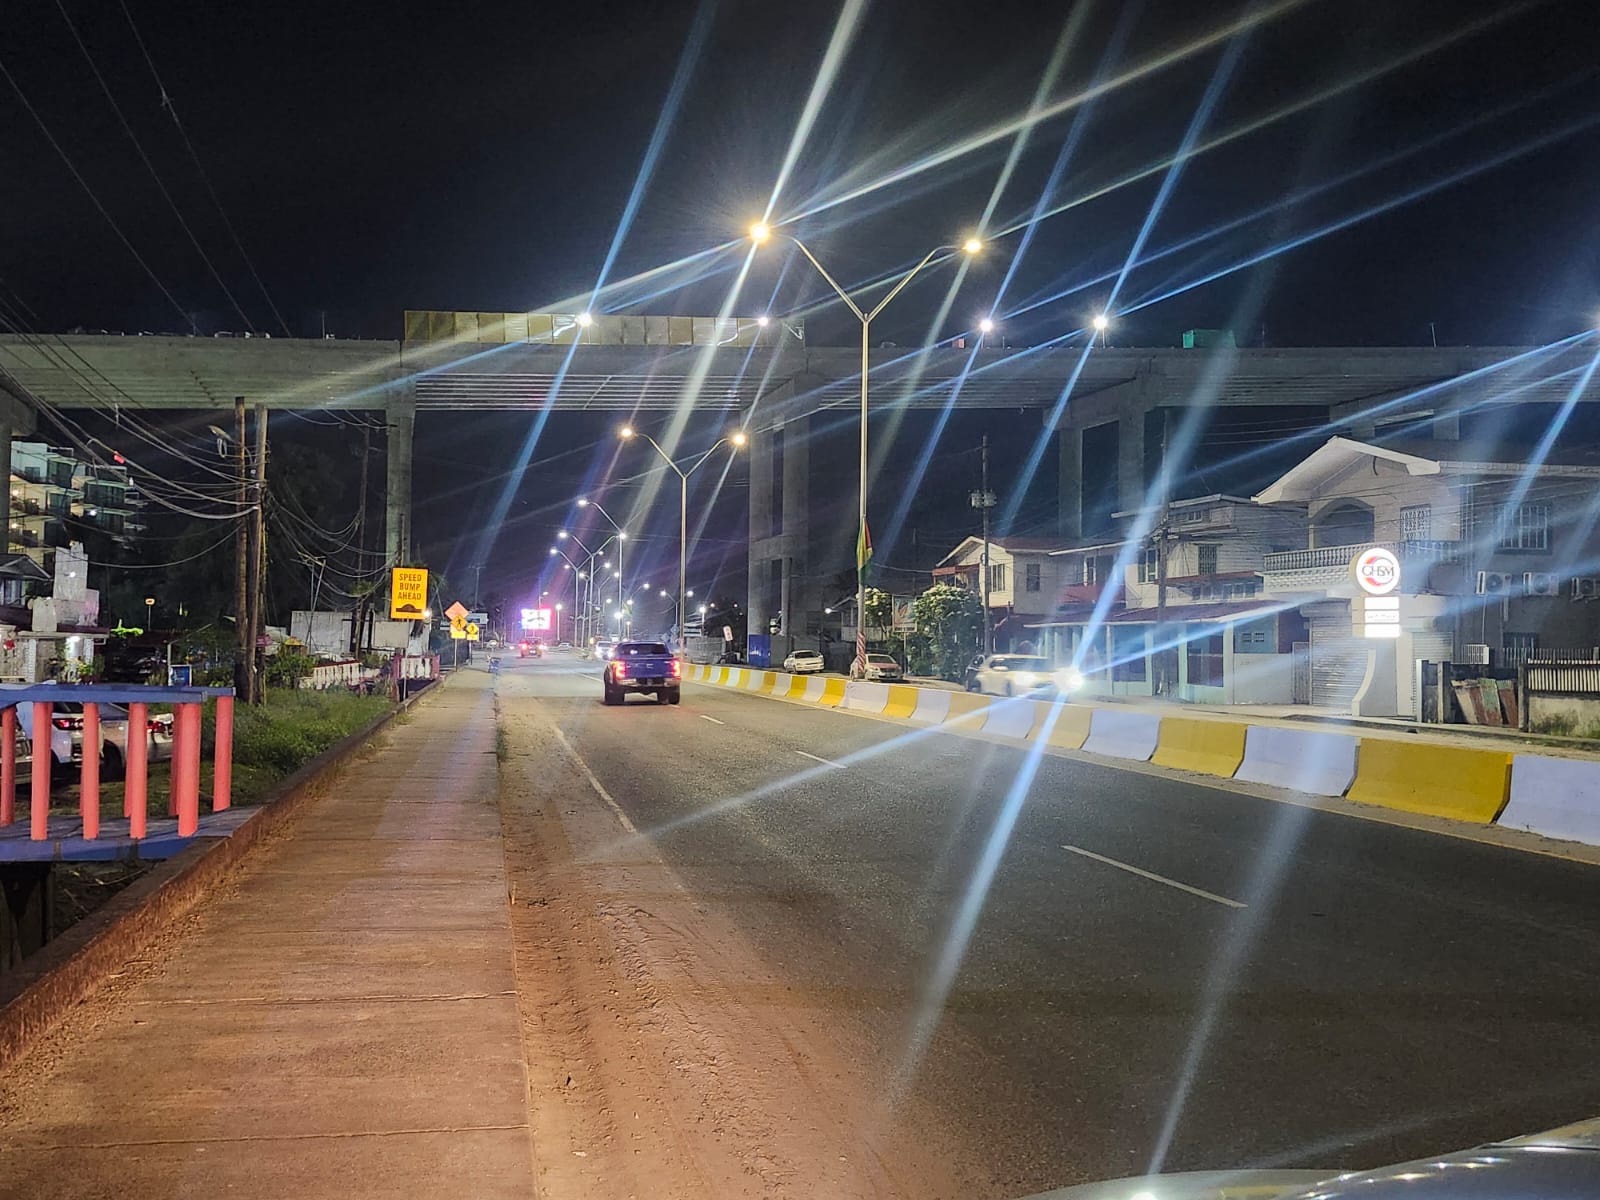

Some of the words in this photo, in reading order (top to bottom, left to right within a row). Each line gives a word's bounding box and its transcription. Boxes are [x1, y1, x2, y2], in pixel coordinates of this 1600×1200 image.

[399, 574, 422, 582] SPEED
[400, 582, 420, 590] BUMP
[398, 592, 422, 600] AHEAD
